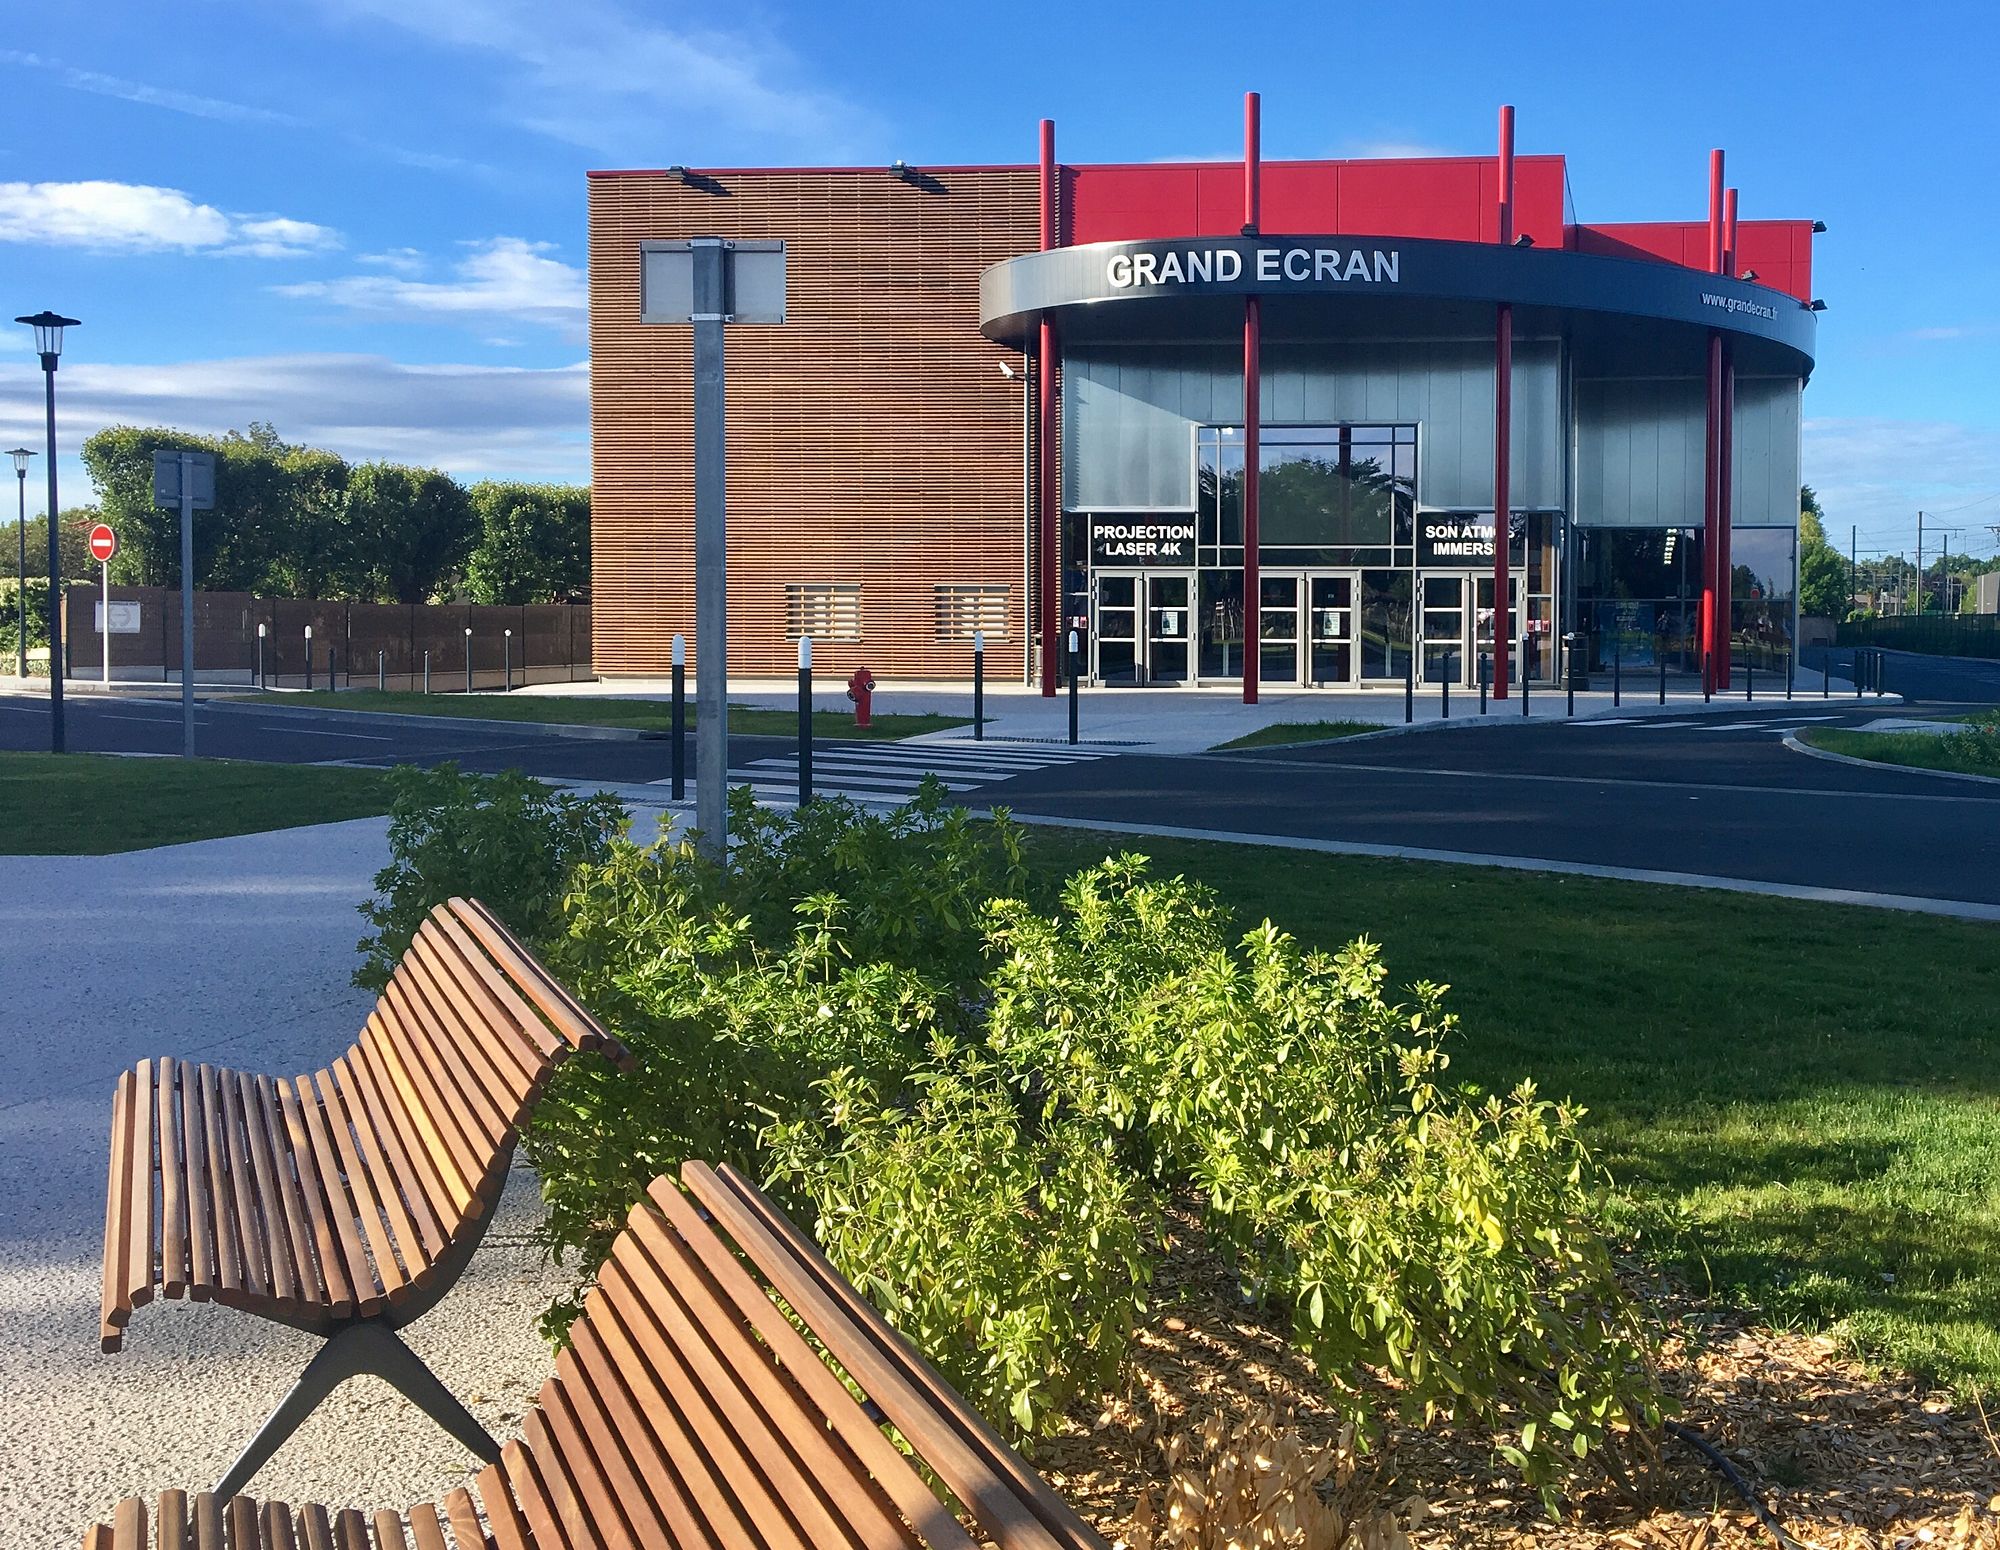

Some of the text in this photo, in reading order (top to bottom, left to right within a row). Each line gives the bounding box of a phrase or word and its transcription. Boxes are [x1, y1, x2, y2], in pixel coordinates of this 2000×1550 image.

[1106, 249, 1399, 288] GRAND ECRAN
[1702, 292, 1778, 320] www.grandecran.fr
[1093, 525, 1194, 539] PROJECTION
[1425, 525, 1515, 539] SON ATMS
[1105, 542, 1182, 556] LASER 4K
